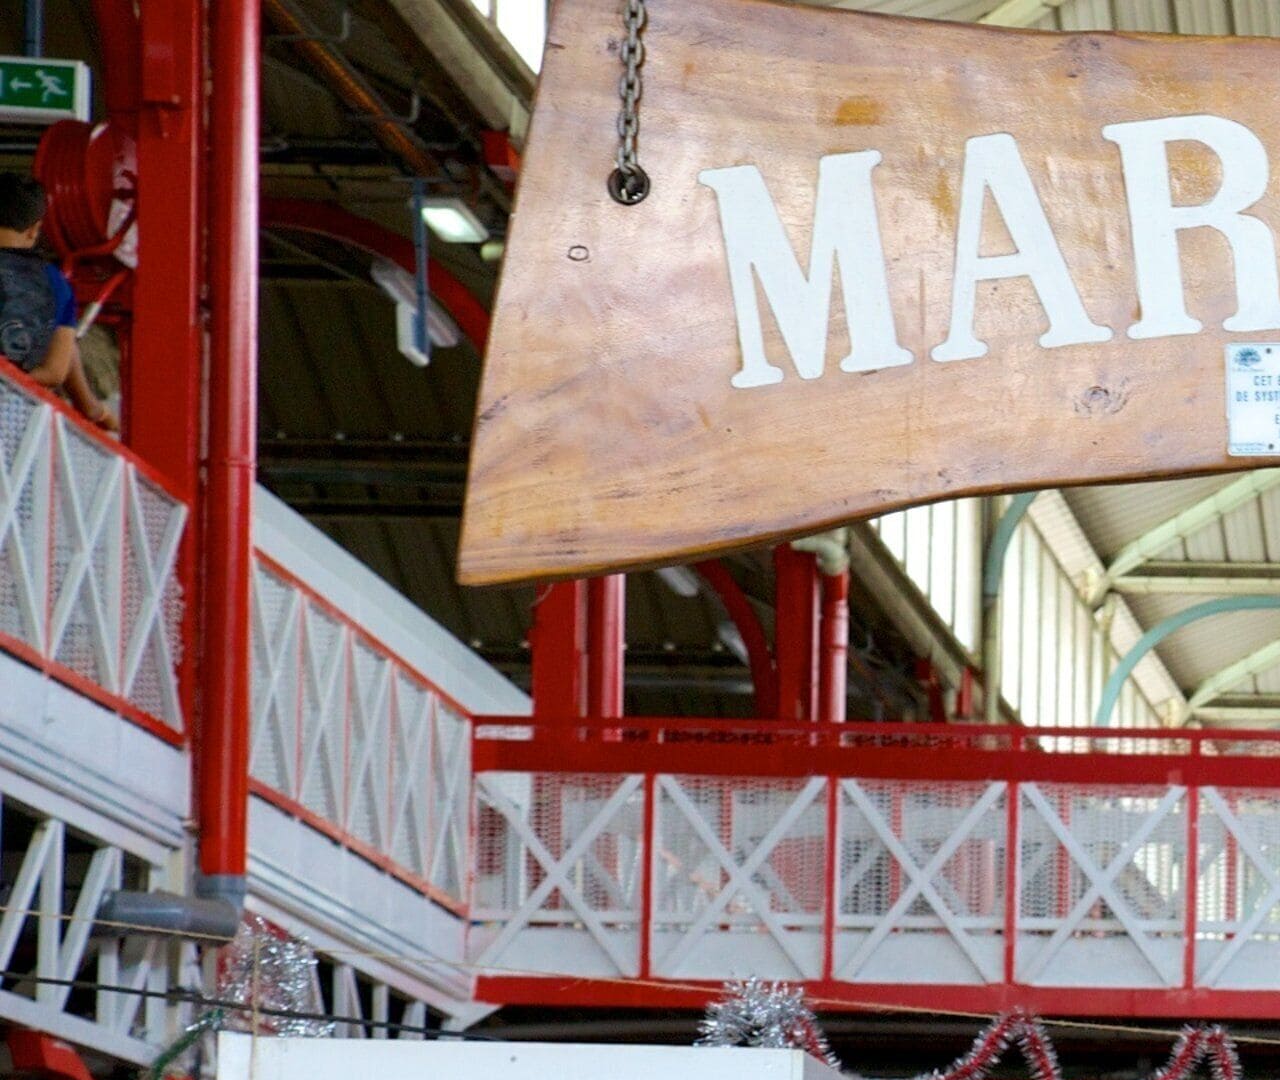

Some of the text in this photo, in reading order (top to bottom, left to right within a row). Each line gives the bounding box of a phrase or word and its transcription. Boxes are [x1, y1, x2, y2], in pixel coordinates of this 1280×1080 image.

[1254, 374, 1272, 386] CET
[1236, 390, 1249, 402] DE
[1275, 413, 1280, 425] E
